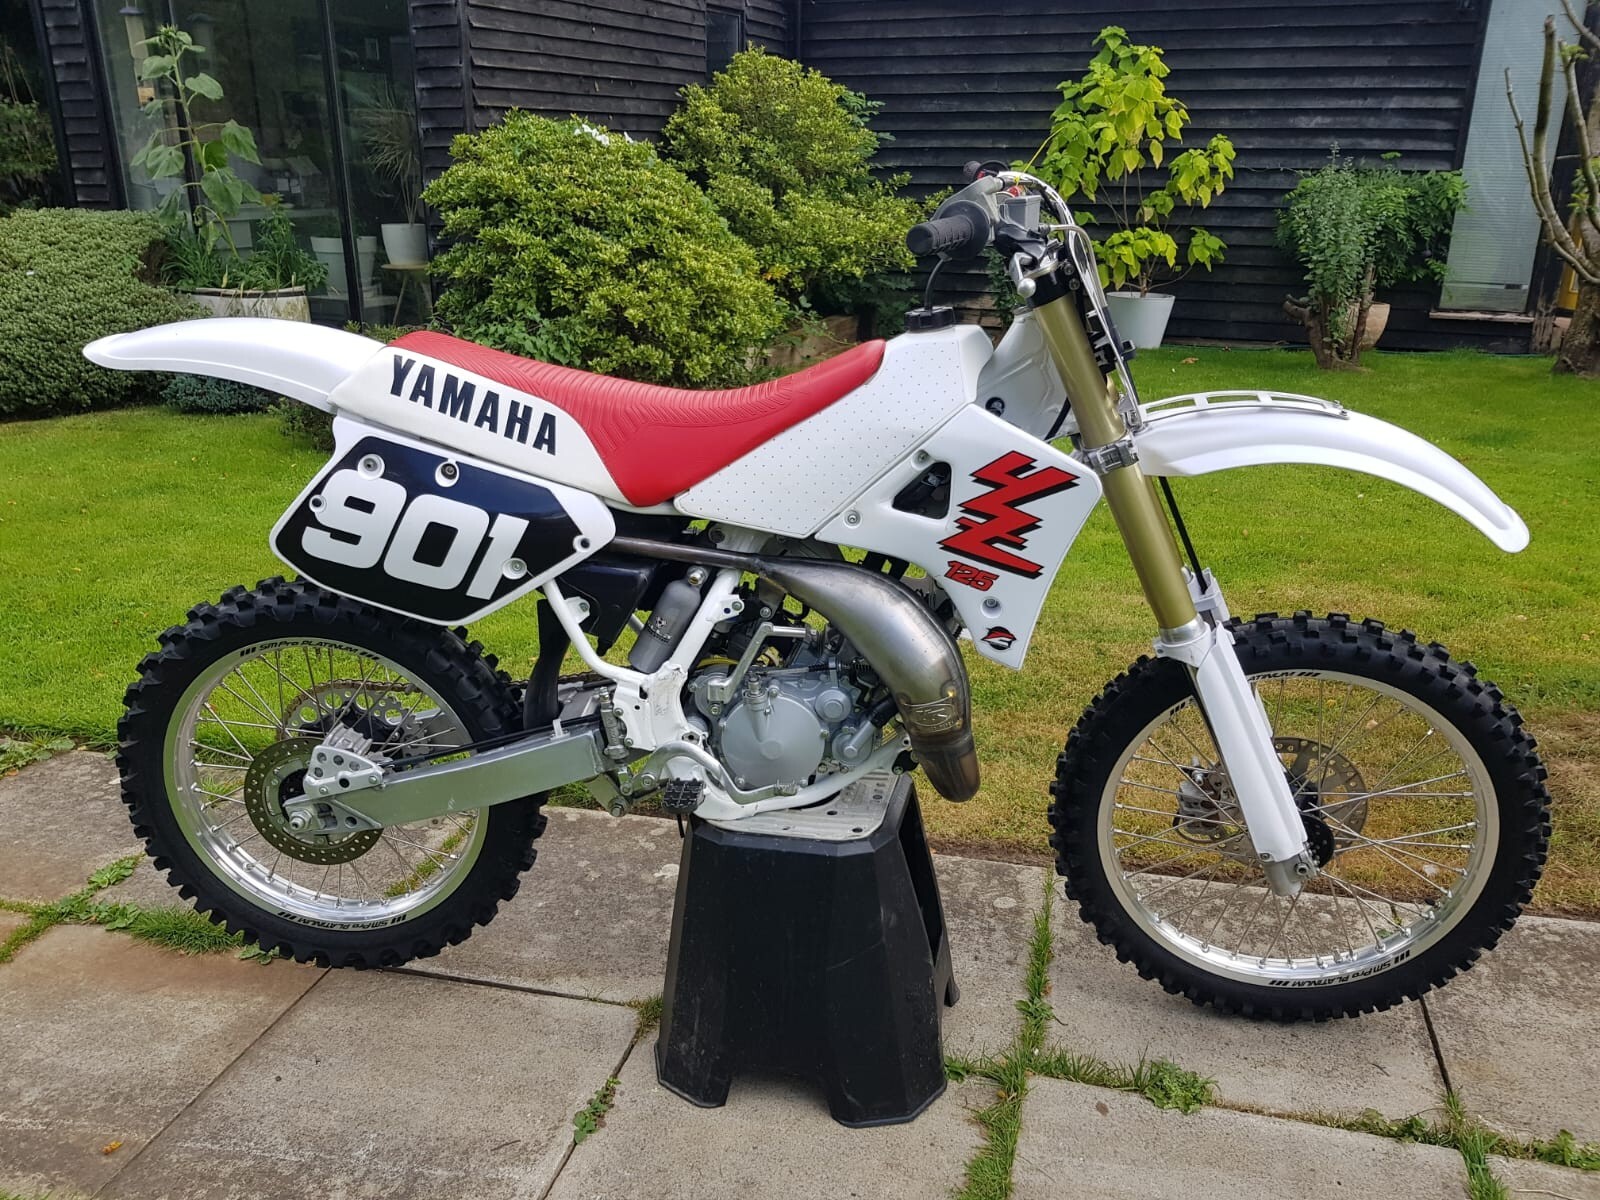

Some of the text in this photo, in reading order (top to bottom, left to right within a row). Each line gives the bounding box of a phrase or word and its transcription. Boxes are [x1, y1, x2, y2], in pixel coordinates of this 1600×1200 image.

[389, 354, 557, 456] YAMAHA
[301, 468, 530, 600] 901
[944, 560, 1000, 591] 125
[300, 640, 358, 653] PLATINUM
[298, 917, 351, 930] PLATINUM
[1291, 974, 1350, 987] PLATINUM
